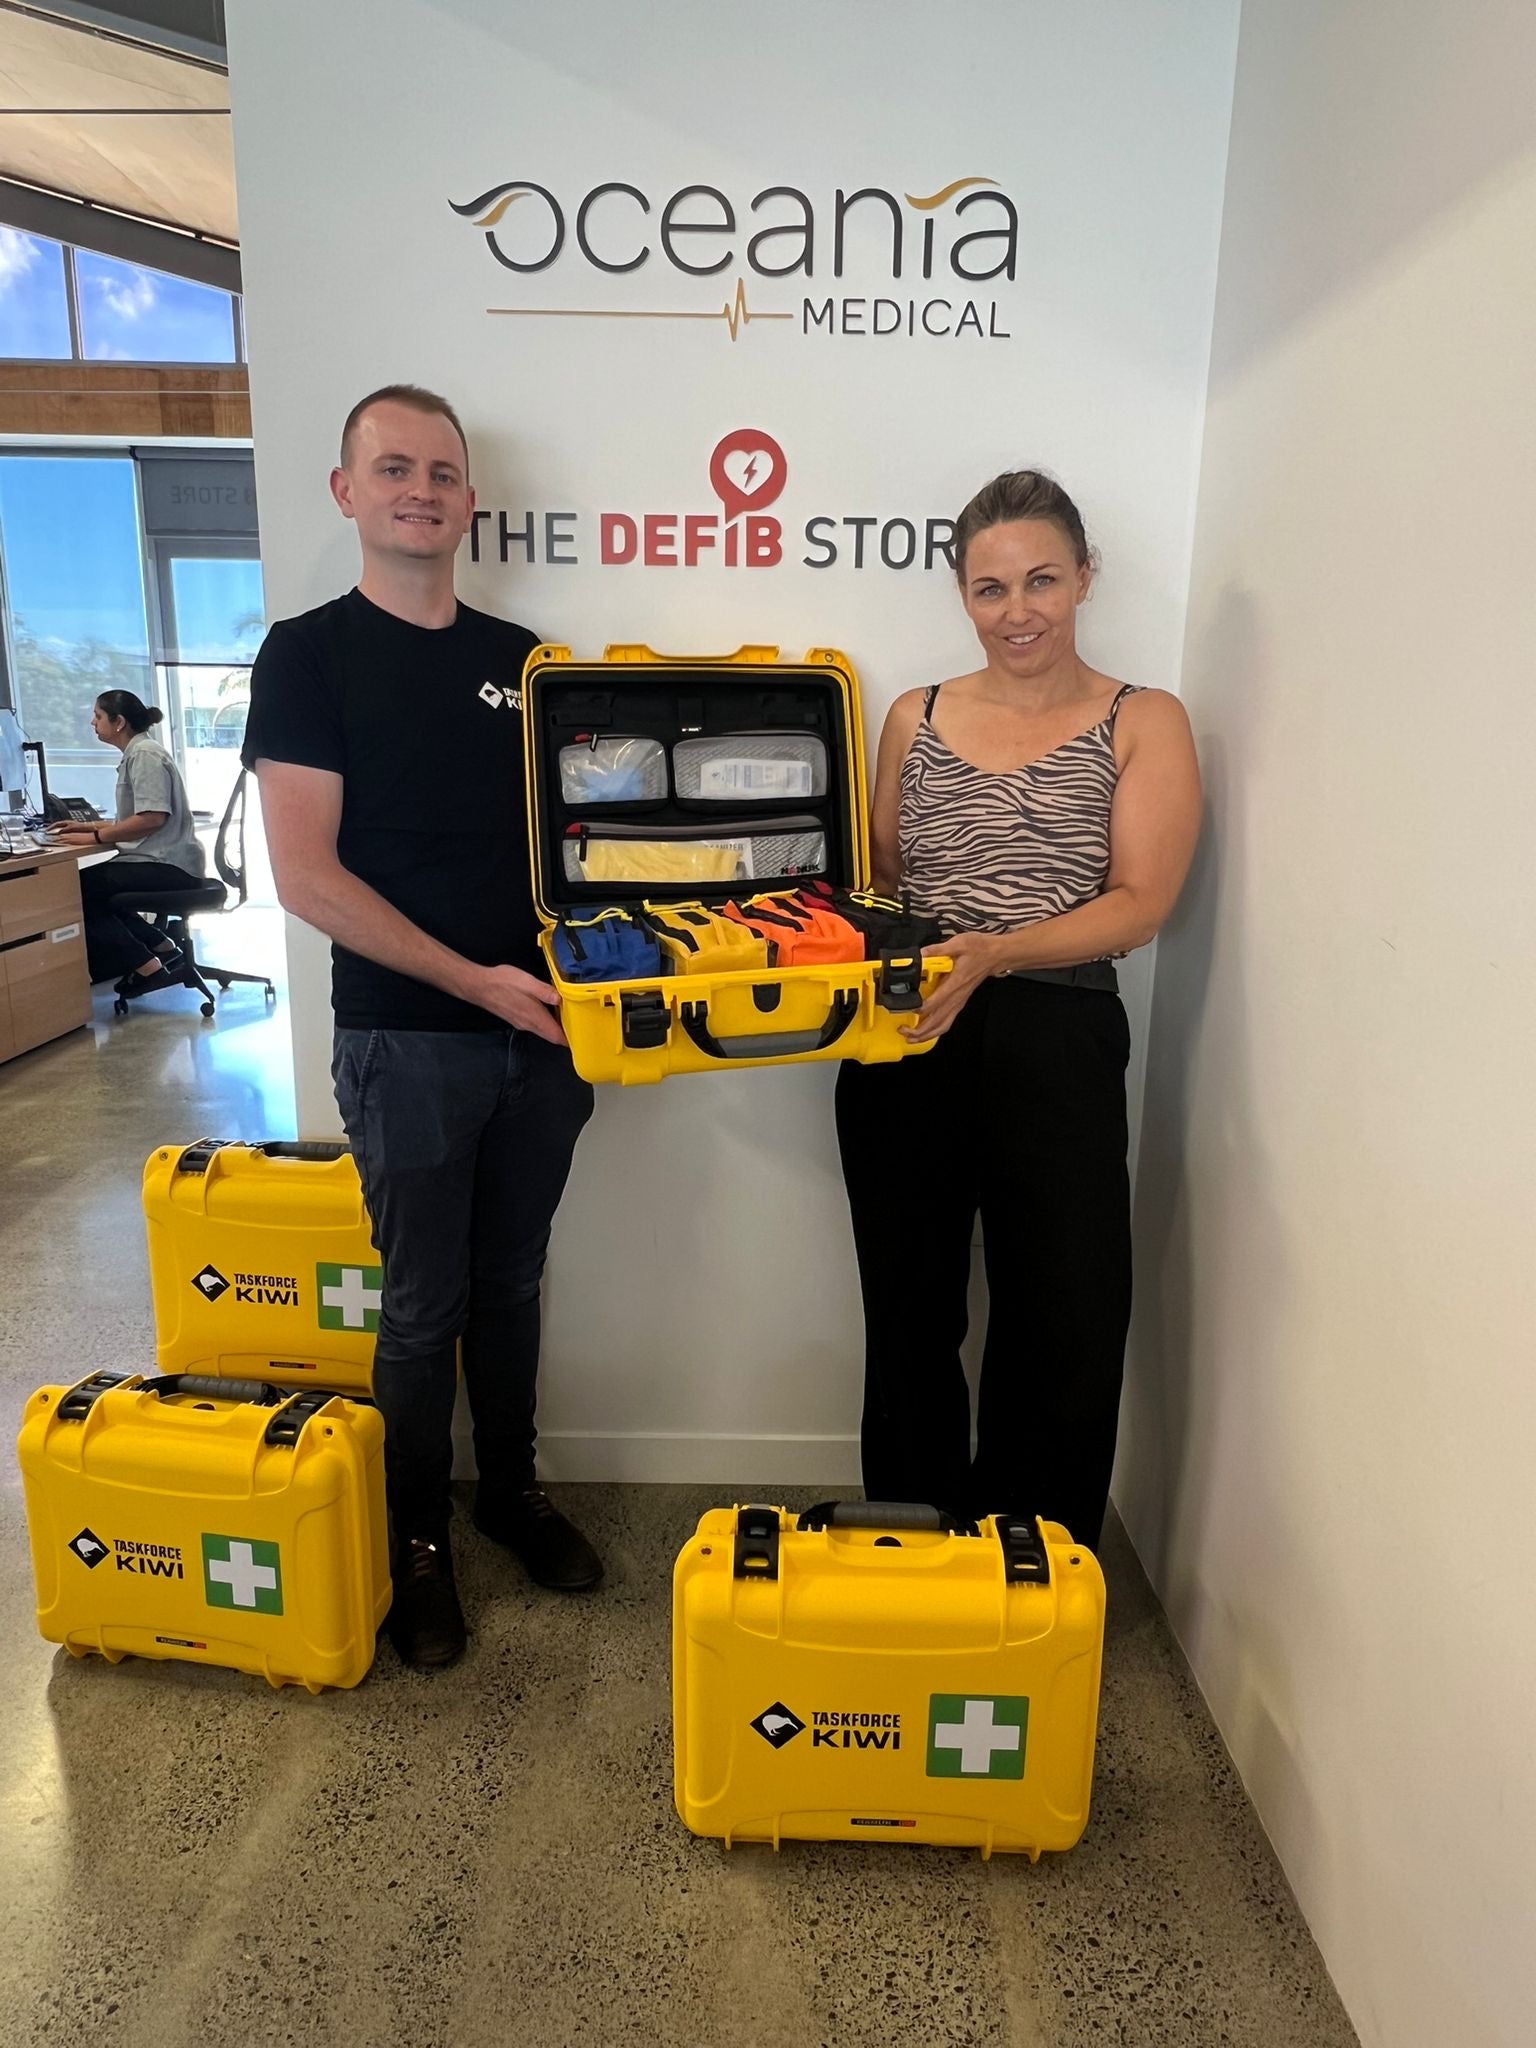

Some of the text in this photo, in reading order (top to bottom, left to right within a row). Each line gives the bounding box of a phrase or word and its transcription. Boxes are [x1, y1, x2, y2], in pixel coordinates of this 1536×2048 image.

[803, 298, 1011, 338] MEDICAL
[471, 511, 578, 565] THE
[803, 516, 958, 570] STOR
[233, 1273, 298, 1289] TASKFORCE
[235, 1286, 299, 1307] KIWI
[113, 1539, 182, 1561] TASKFORCE
[115, 1554, 184, 1579] KIWI
[811, 1712, 901, 1728] TASKFORCE
[812, 1729, 901, 1750] KIWI
